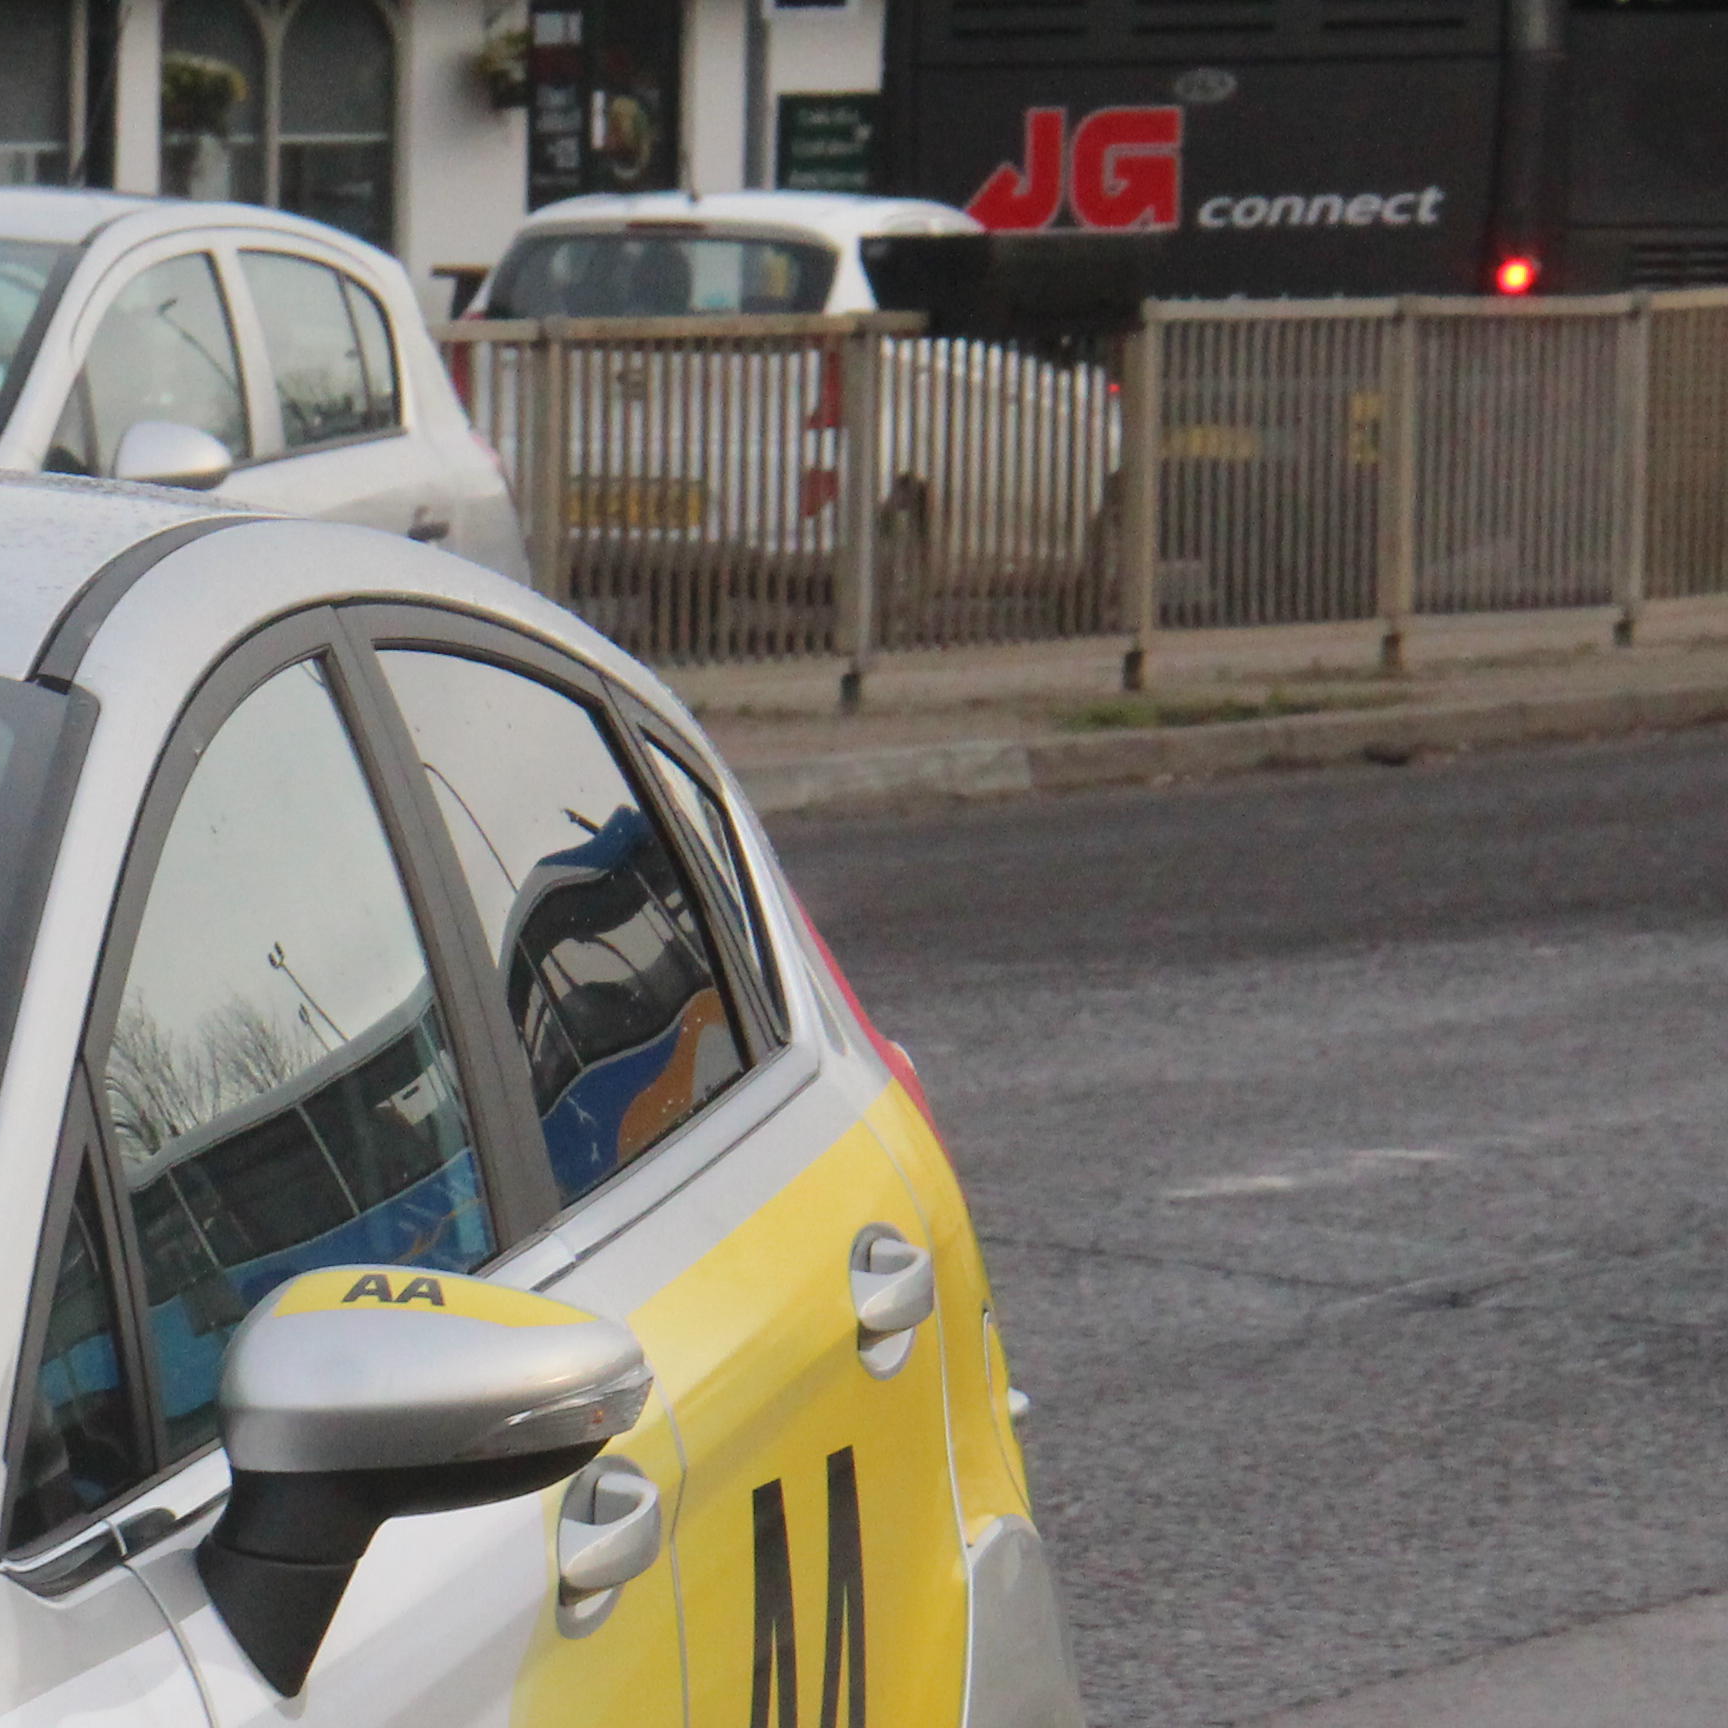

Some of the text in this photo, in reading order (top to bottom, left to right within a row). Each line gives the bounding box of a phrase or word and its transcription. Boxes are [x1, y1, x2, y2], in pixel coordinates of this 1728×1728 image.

[965, 106, 1444, 232] JG connect
[341, 1274, 445, 1308] AA
